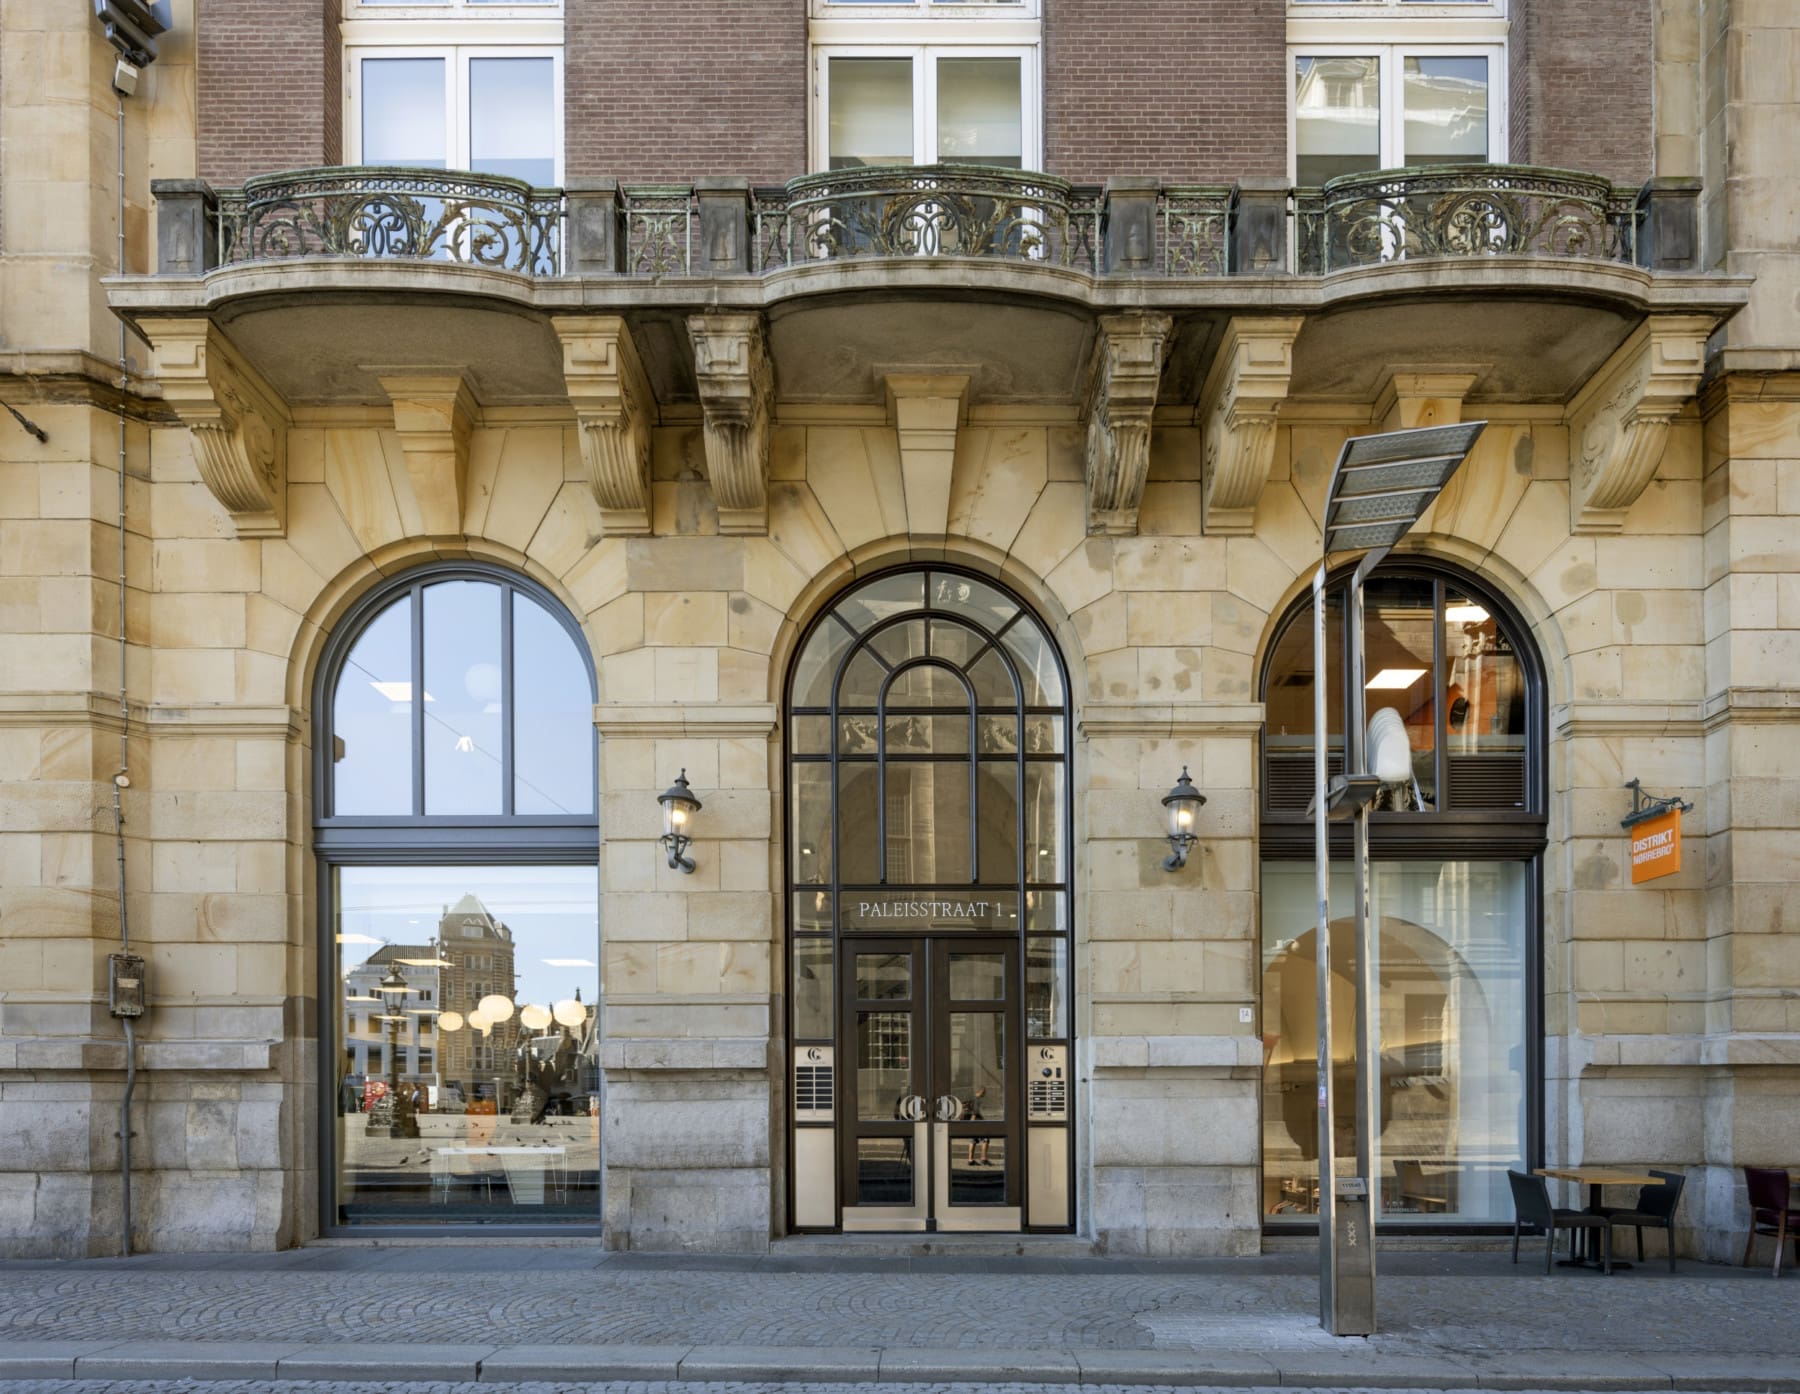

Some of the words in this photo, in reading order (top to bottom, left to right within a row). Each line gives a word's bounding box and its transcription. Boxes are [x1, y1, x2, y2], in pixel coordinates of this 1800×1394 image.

[1633, 829, 1674, 854] DISTRIKT
[859, 902, 989, 917] PALEISSTRAAT
[996, 902, 1003, 917] 1
